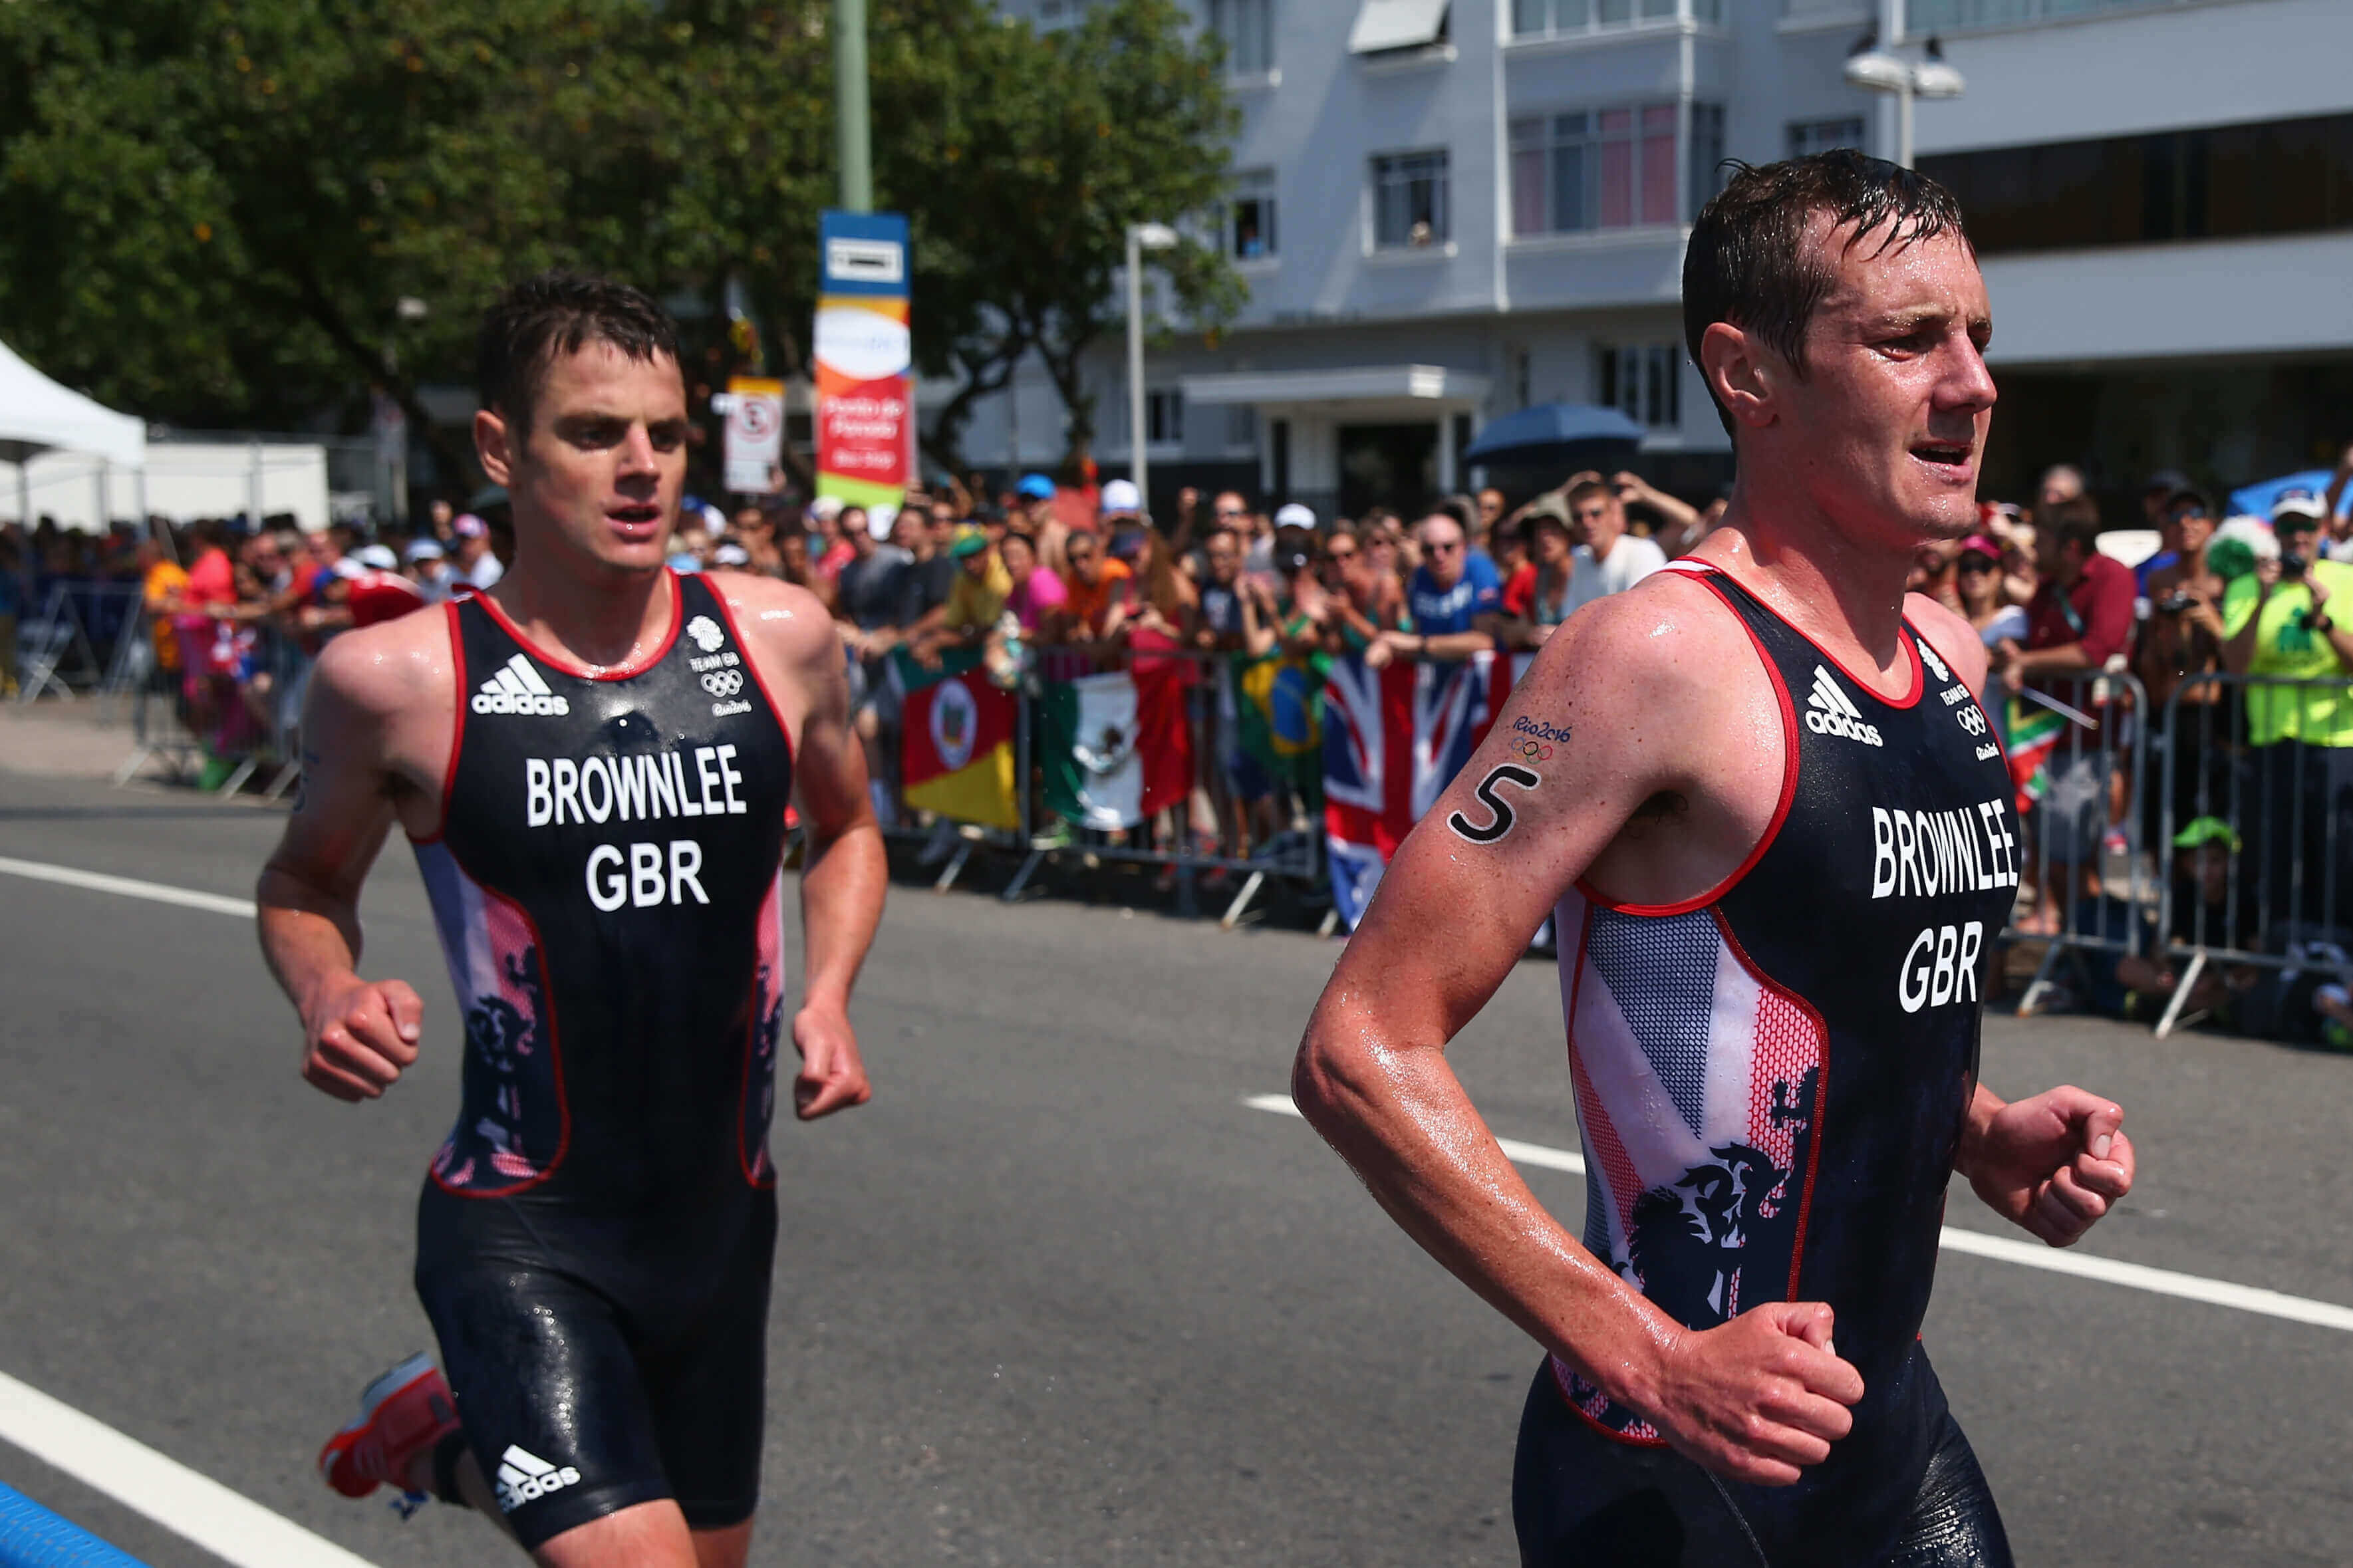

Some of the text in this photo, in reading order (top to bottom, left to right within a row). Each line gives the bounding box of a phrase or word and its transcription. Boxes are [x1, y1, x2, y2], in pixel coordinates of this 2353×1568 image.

[689, 654, 724, 672] TEAM
[1940, 686, 1964, 706] TEAM
[470, 691, 570, 716] adidas
[1805, 709, 1883, 747] adidas
[525, 744, 747, 827] BROWNLEE
[1447, 763, 1542, 845] 5
[586, 840, 710, 912] GBR
[1871, 798, 2018, 899] BROWNLEE
[1899, 921, 1983, 1013] GBR
